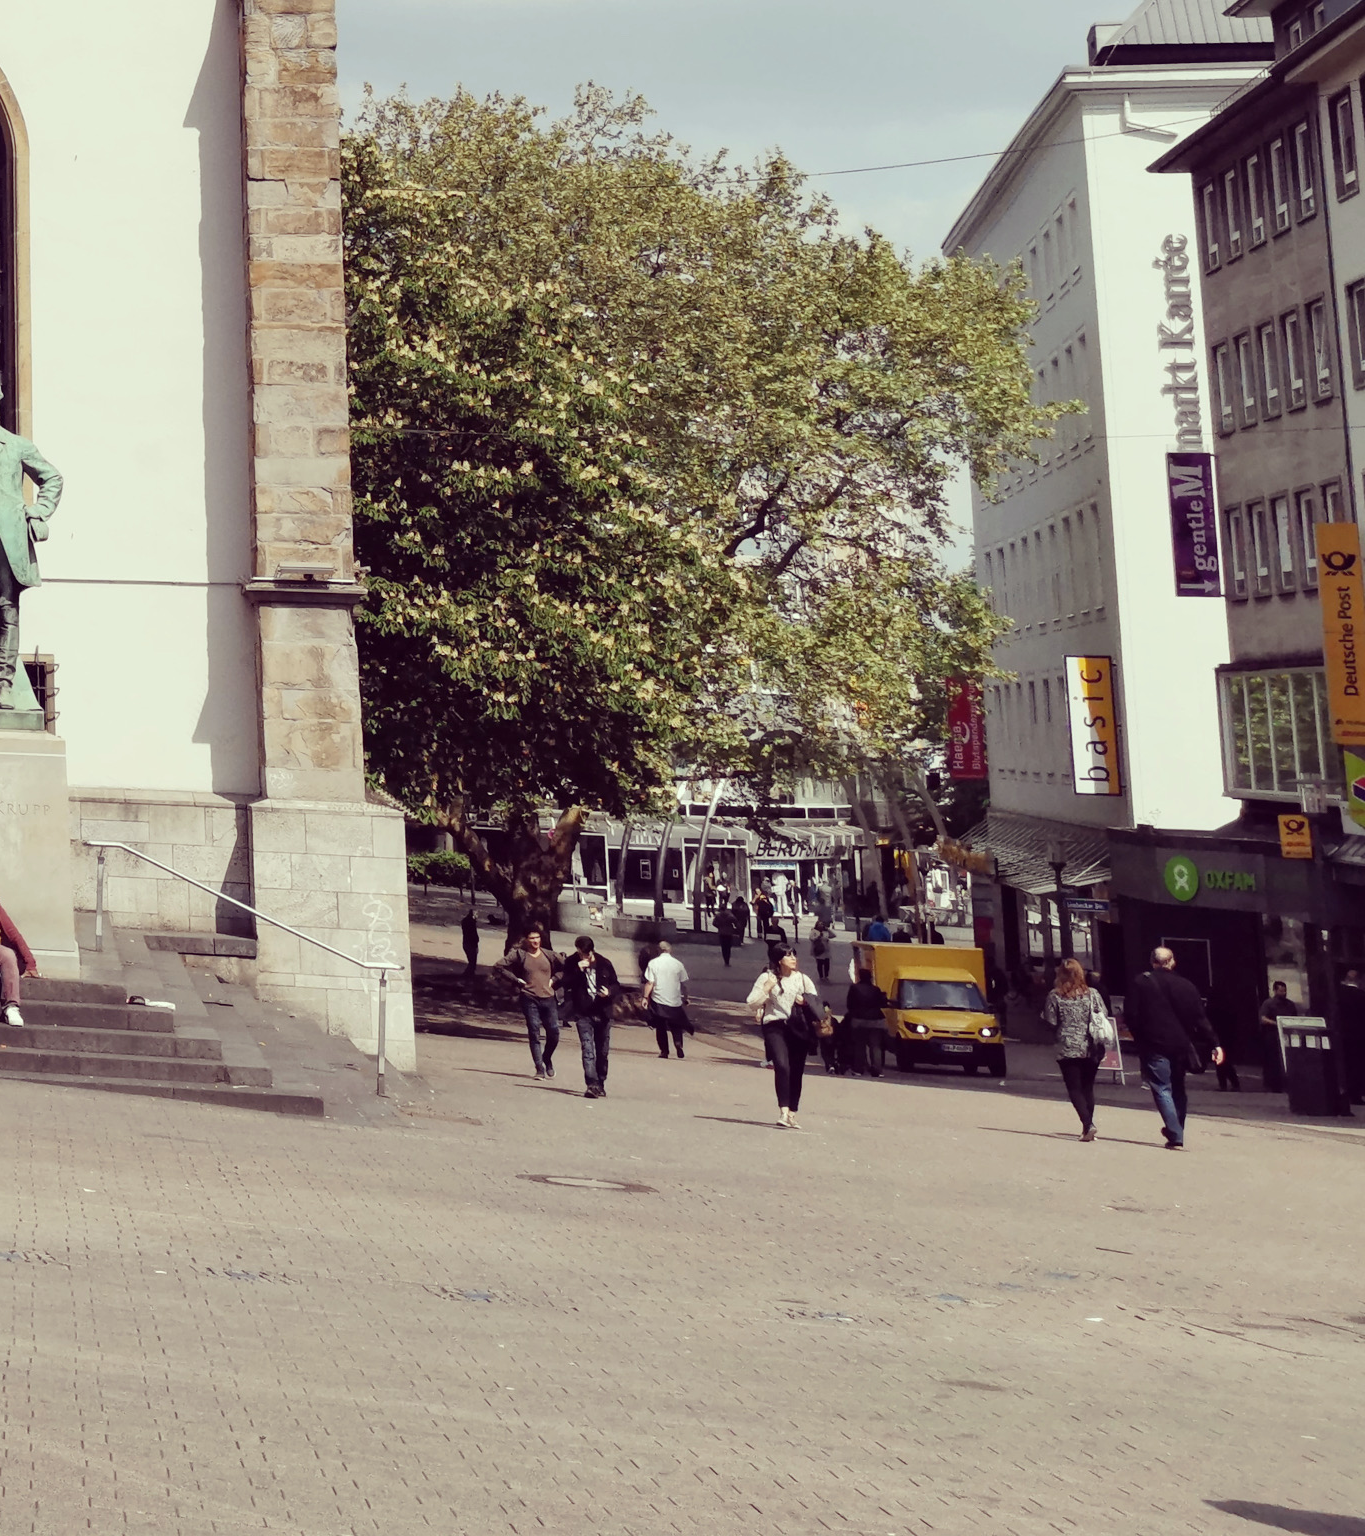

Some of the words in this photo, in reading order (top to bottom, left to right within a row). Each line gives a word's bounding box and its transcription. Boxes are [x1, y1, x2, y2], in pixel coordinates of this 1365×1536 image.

[1337, 585, 1352, 620] Post
[1338, 621, 1360, 697] Deutsche
[1073, 669, 1111, 783] basic
[1205, 871, 1257, 891] OXFAM
